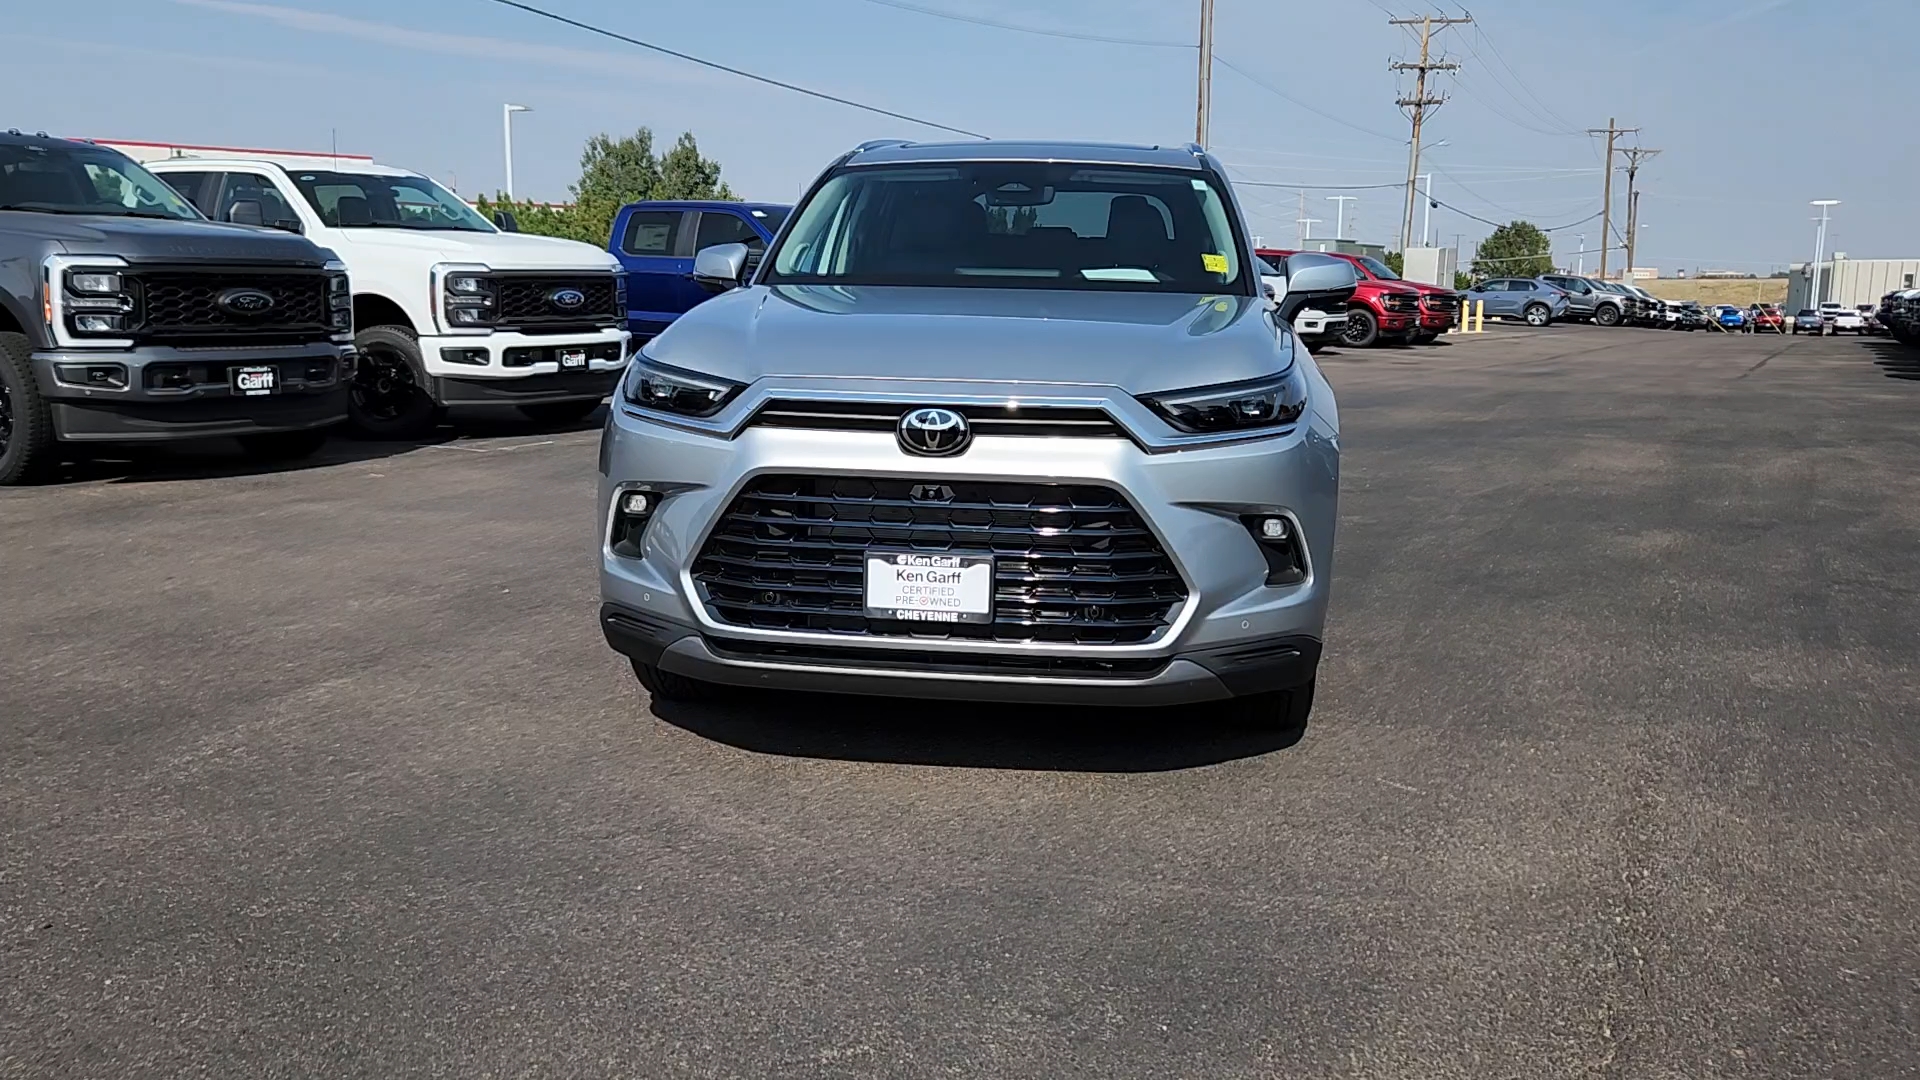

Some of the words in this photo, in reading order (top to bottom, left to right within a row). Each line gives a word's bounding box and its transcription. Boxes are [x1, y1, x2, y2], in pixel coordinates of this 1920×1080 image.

[237, 296, 264, 309] Ford
[562, 353, 586, 367] Garff
[237, 372, 274, 389] Garff
[907, 555, 930, 567] Ken
[931, 556, 961, 568] Garff
[896, 569, 924, 582] Ken
[926, 571, 962, 584] Garff
[902, 585, 955, 596] CERTIFIED
[896, 609, 959, 622] CHEYENNE
